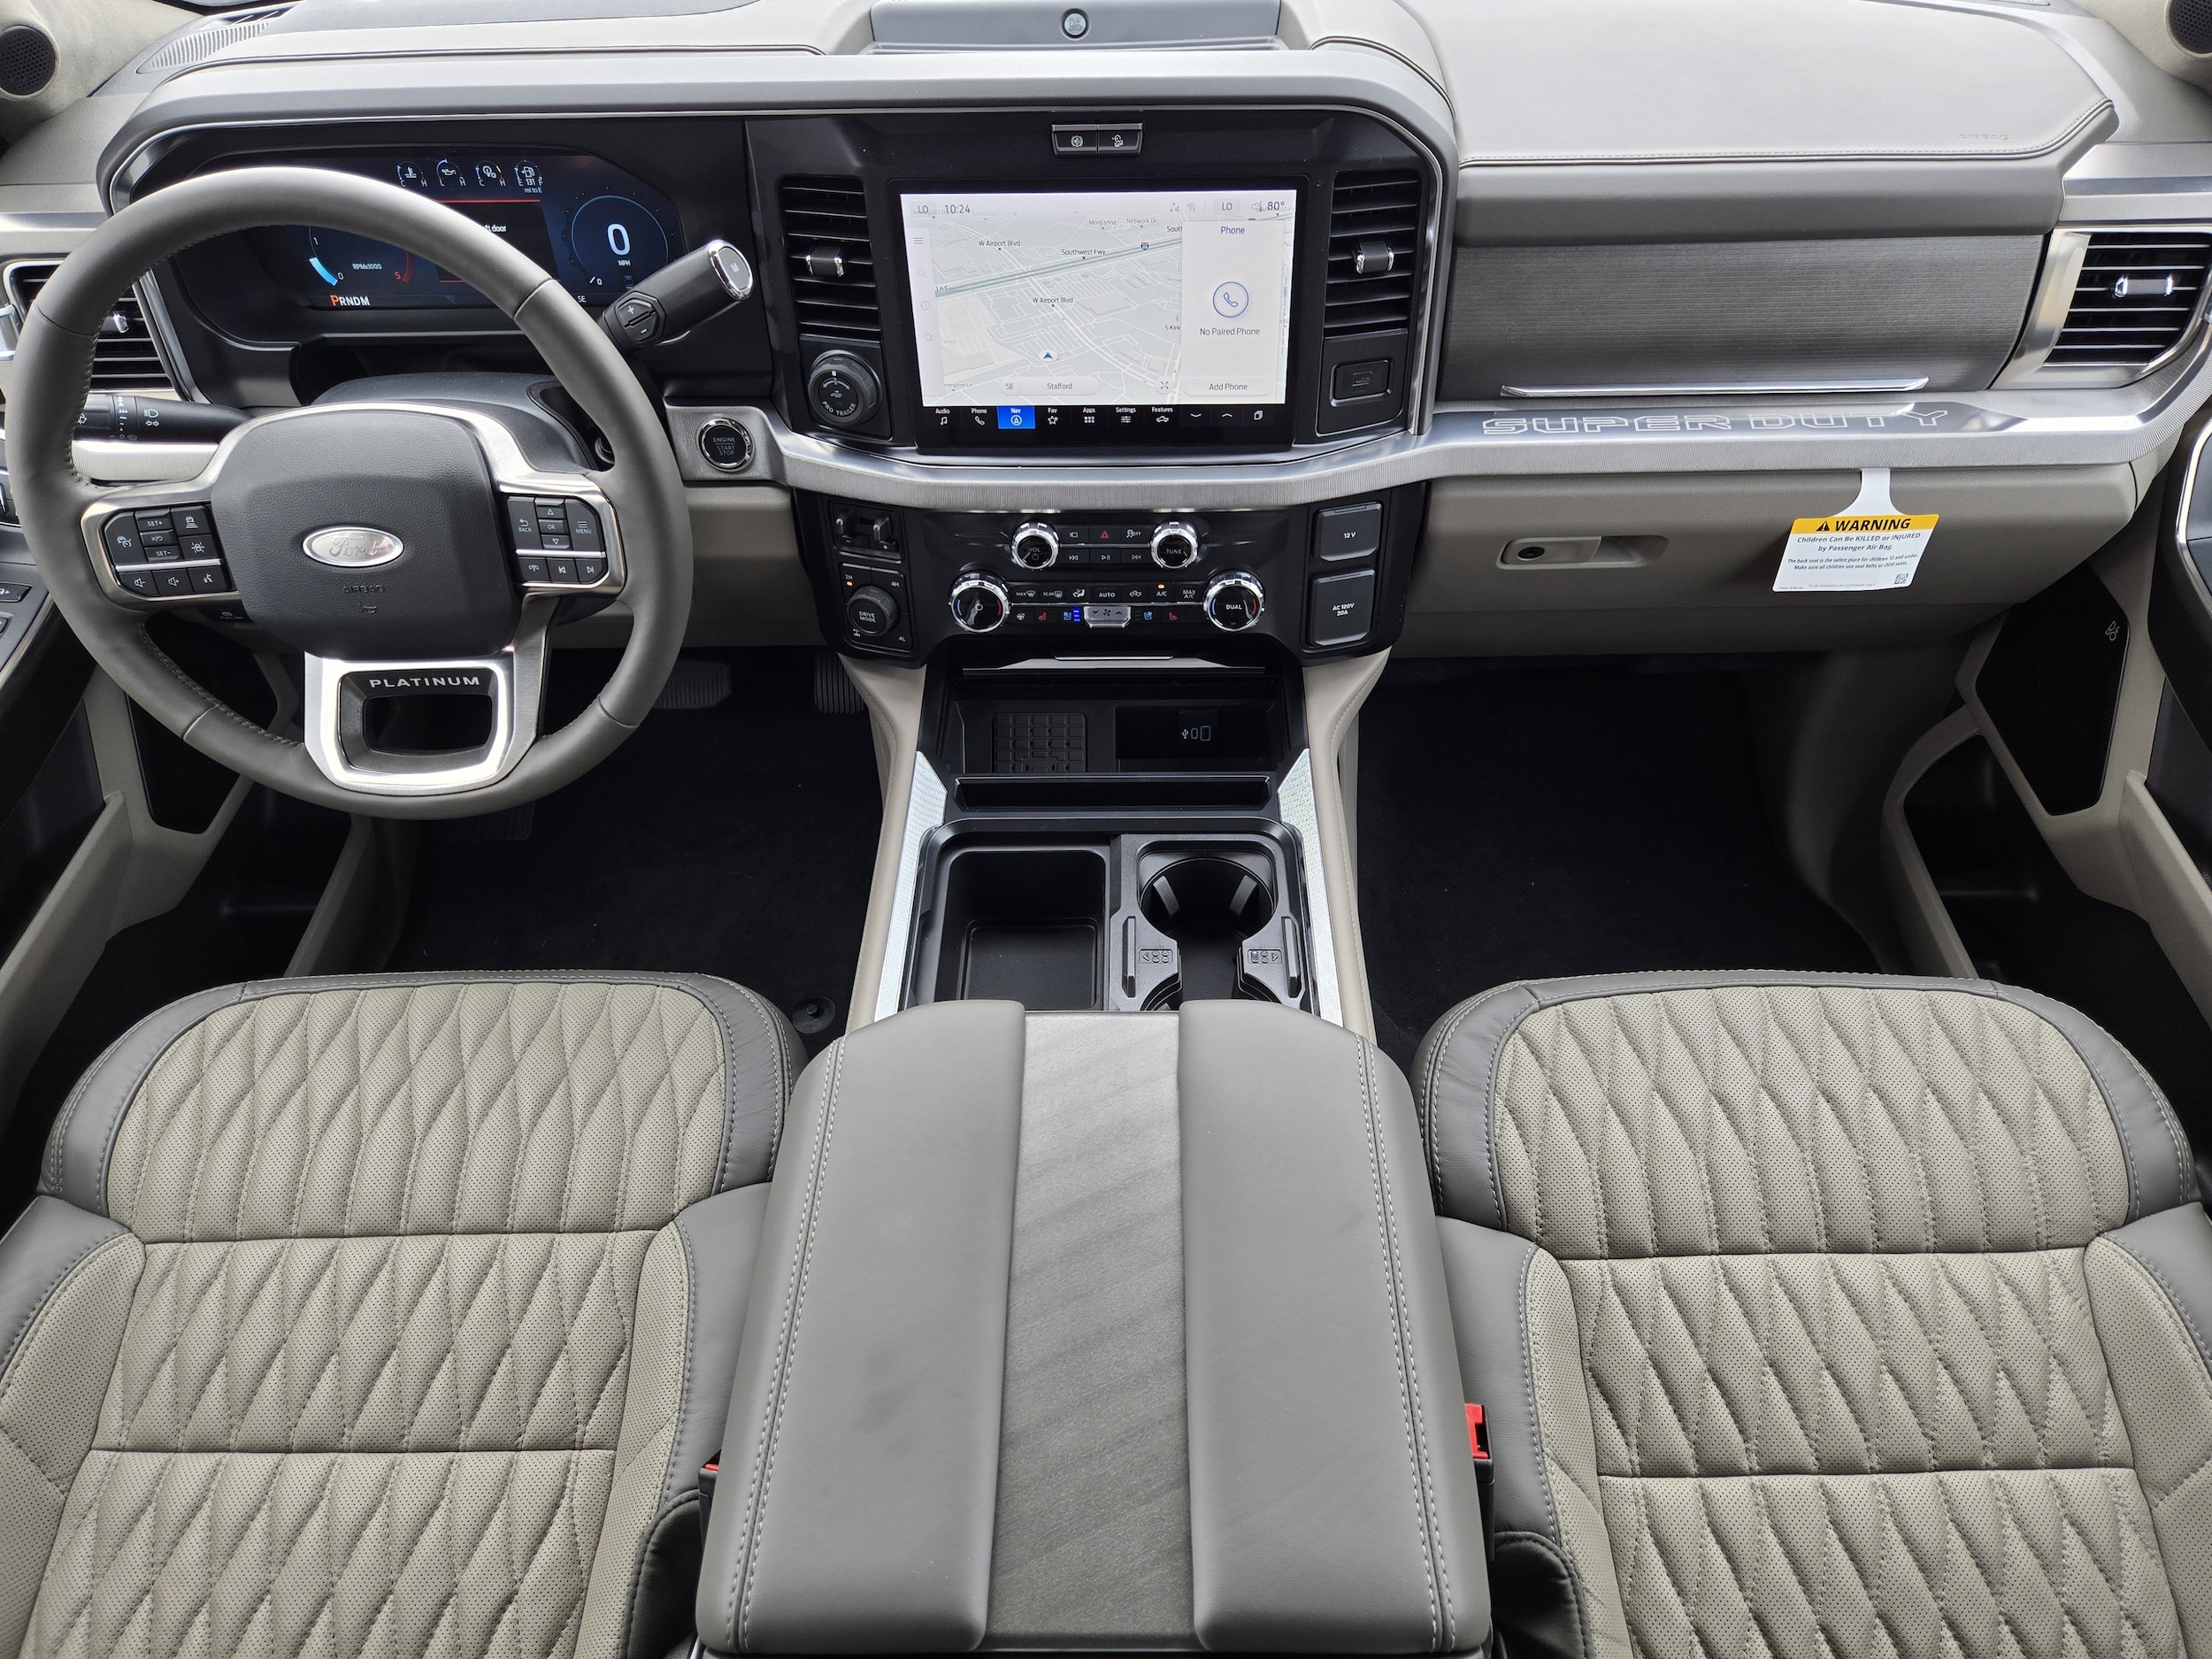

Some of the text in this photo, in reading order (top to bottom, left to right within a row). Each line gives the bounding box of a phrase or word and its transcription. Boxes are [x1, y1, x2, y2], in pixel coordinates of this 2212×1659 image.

[918, 205, 929, 214] LO
[945, 204, 971, 214] 10:24
[607, 223, 631, 256] 0
[395, 271, 402, 280] 5
[822, 401, 856, 416] PRO TRAILER
[1482, 410, 1948, 434] SUPER DUTY
[1835, 518, 1911, 531] WARNING
[329, 534, 380, 557] Ford
[370, 677, 480, 687] PLATINUM
